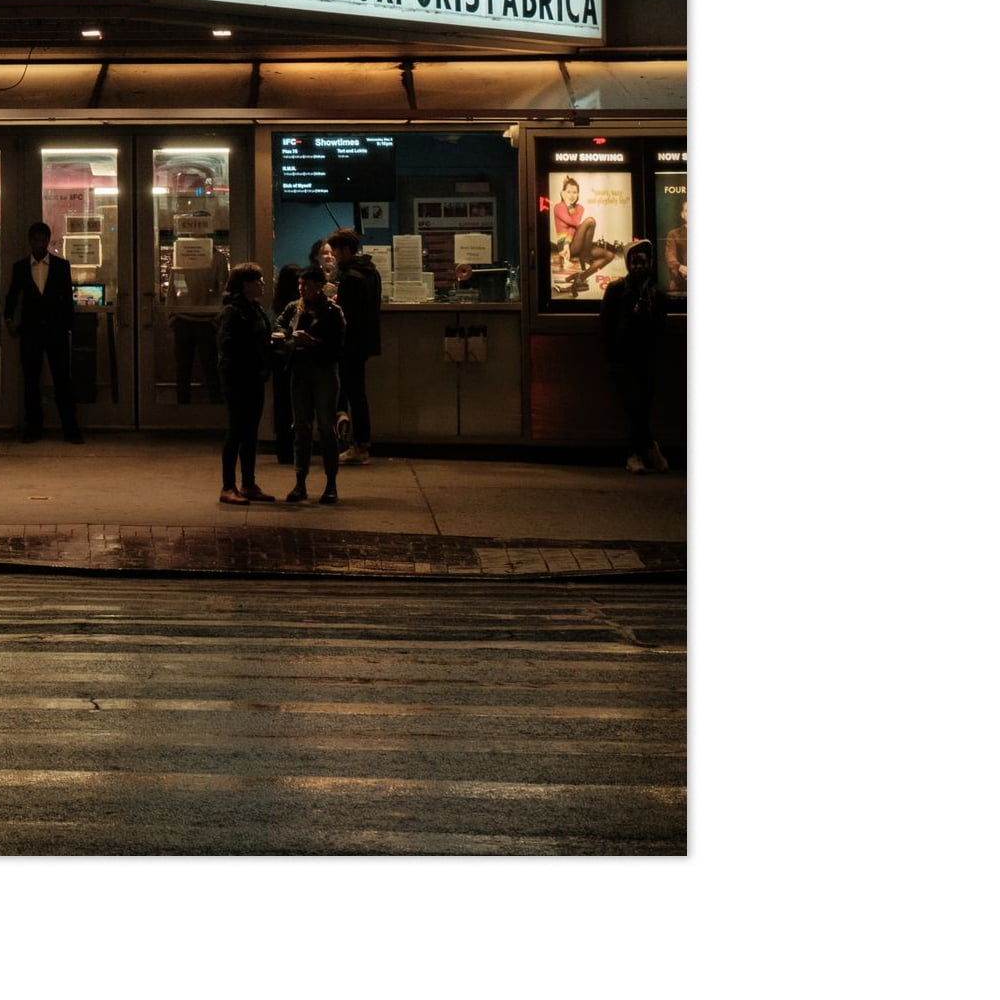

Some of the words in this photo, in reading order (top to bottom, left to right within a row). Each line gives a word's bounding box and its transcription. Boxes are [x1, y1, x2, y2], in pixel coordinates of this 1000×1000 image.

[315, 138, 360, 146] Showtimes
[555, 153, 578, 162] NOW
[579, 153, 625, 162] SHOWING
[657, 152, 680, 161] NOW
